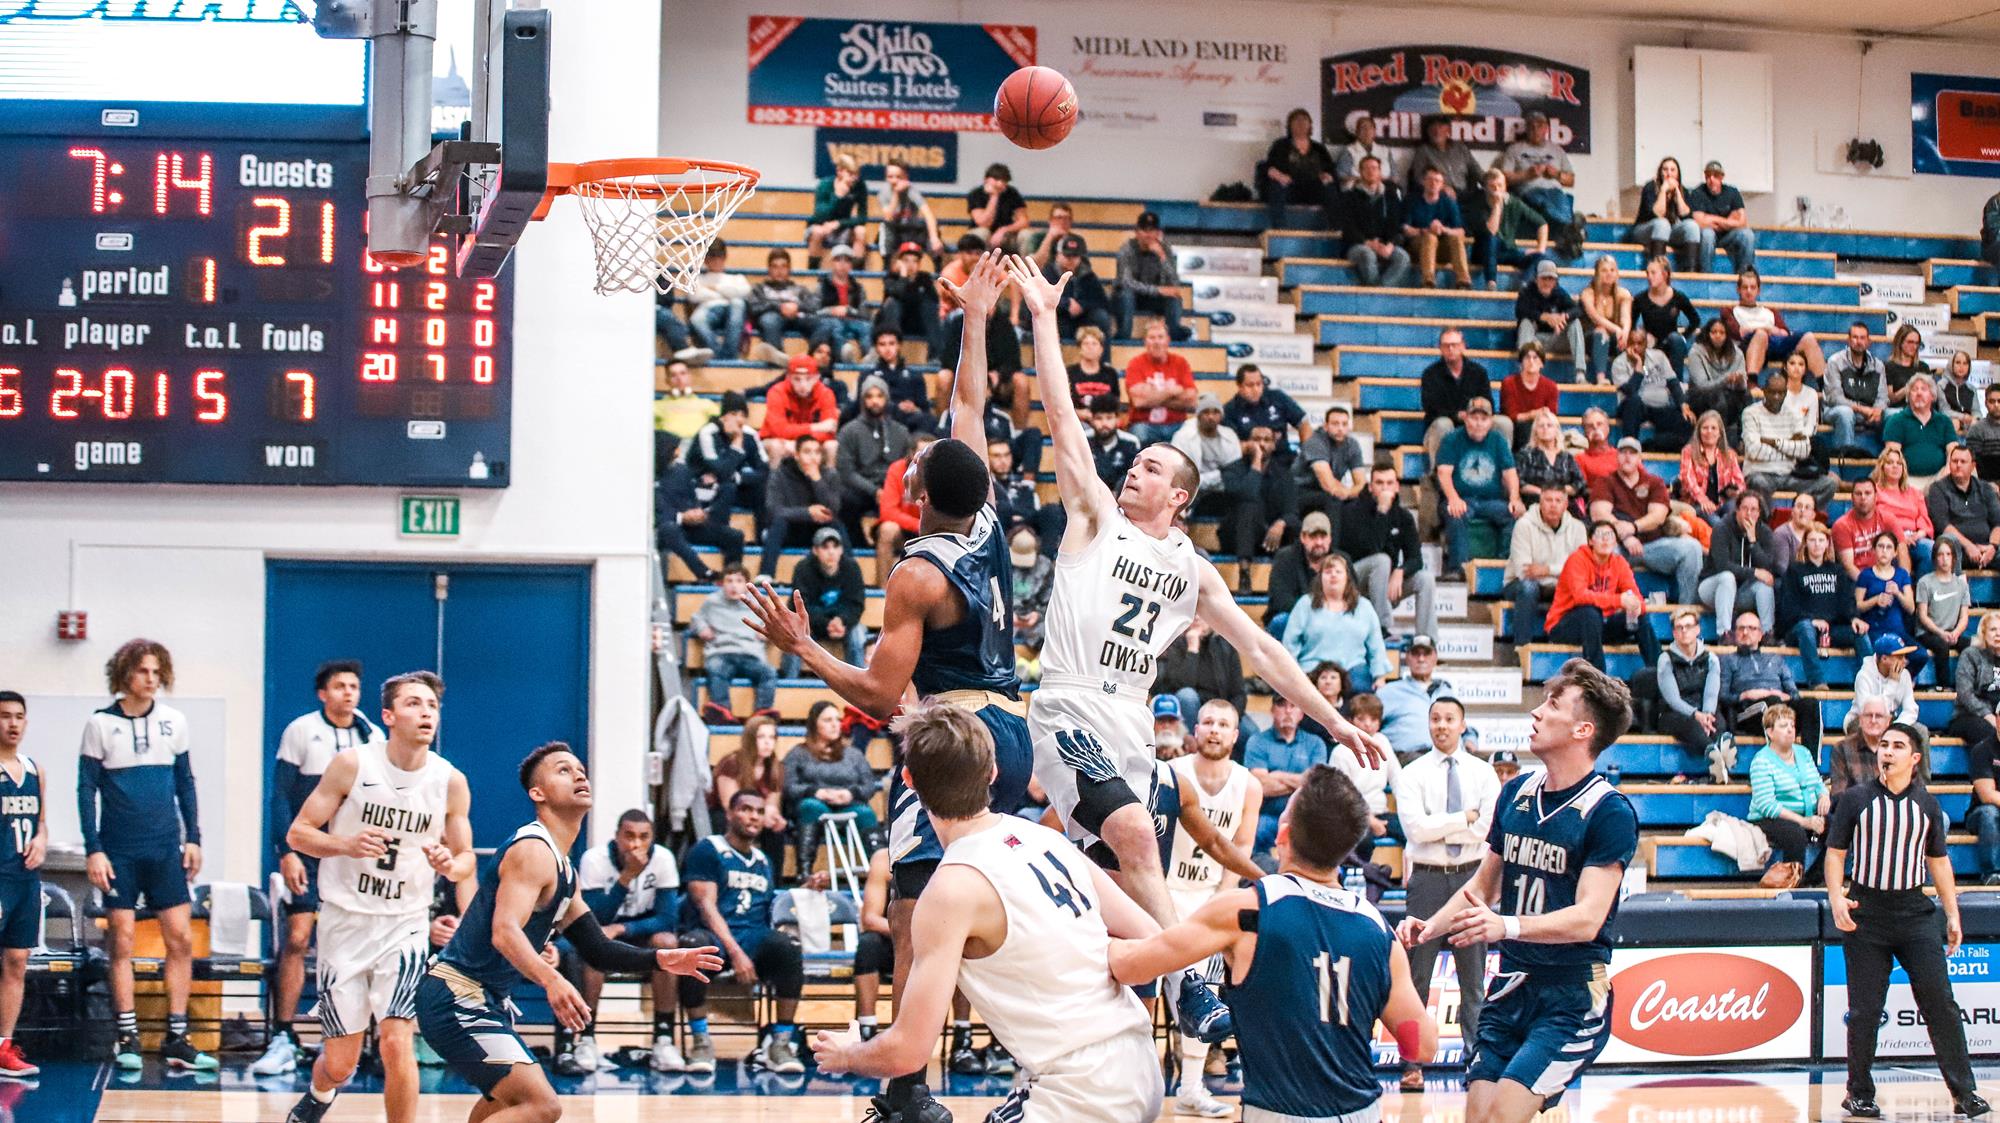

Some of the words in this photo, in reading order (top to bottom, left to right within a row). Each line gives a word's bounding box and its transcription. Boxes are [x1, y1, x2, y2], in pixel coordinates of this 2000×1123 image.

[838, 23, 933, 76] Shilo
[1072, 36, 1188, 58] MIDLAND
[1196, 41, 1287, 63] EMPIRE
[824, 73, 889, 96] Suites
[894, 76, 960, 99] Hotels
[1332, 53, 1408, 93] Red
[1421, 54, 1581, 105] RoostR
[889, 113, 1000, 131] SHILOINNS.C
[1959, 100, 2000, 118] Bas
[1449, 117, 1496, 142] nd
[1504, 117, 1573, 145] Pb
[69, 148, 211, 214] 7:14
[240, 154, 333, 188] Guests
[248, 197, 334, 266] 21
[82, 265, 169, 301] period
[202, 256, 218, 303] 1
[1877, 288, 1913, 299] Subaru
[427, 282, 447, 310] 2
[475, 283, 495, 311] 2
[64, 316, 151, 351] player
[262, 323, 325, 352] fouls
[426, 318, 446, 347] 0
[474, 319, 494, 347] 0
[1901, 317, 1938, 327] Subaru
[1258, 349, 1301, 360] Subaru
[1929, 345, 1954, 355] Suba
[362, 353, 397, 381] 20
[426, 353, 446, 382] 7
[474, 355, 494, 383] 0
[1970, 375, 1994, 385] baru
[196, 370, 227, 421] 5
[285, 371, 316, 420] 7
[75, 441, 141, 469] game
[265, 445, 316, 467] won
[408, 500, 455, 533] EXIT
[1112, 555, 1188, 602] HUSTLIN
[1810, 583, 1836, 594] YOUNG
[989, 575, 1006, 632] 4
[1111, 592, 1161, 645] 23
[1099, 640, 1154, 675] OWLS
[1437, 640, 1478, 653] ubaru
[1457, 686, 1508, 699] Subaru
[158, 720, 173, 737] 15
[1485, 732, 1530, 745] Subar
[361, 802, 433, 834] HUSTLIN
[11, 818, 33, 853] 12
[376, 838, 401, 872] 5
[1503, 833, 1520, 864] UC
[1517, 836, 1567, 875] MERCED
[358, 873, 406, 900] OWLS
[1027, 850, 1093, 919] 41
[1968, 947, 1989, 958] Falls
[1947, 959, 1989, 976] baru
[1312, 950, 1350, 1027] 11
[1629, 979, 1770, 1031] Coastal
[1897, 1008, 2000, 1027] SUAR
[1876, 1039, 1932, 1050] nfidence
[1967, 1037, 1993, 1047] tion
